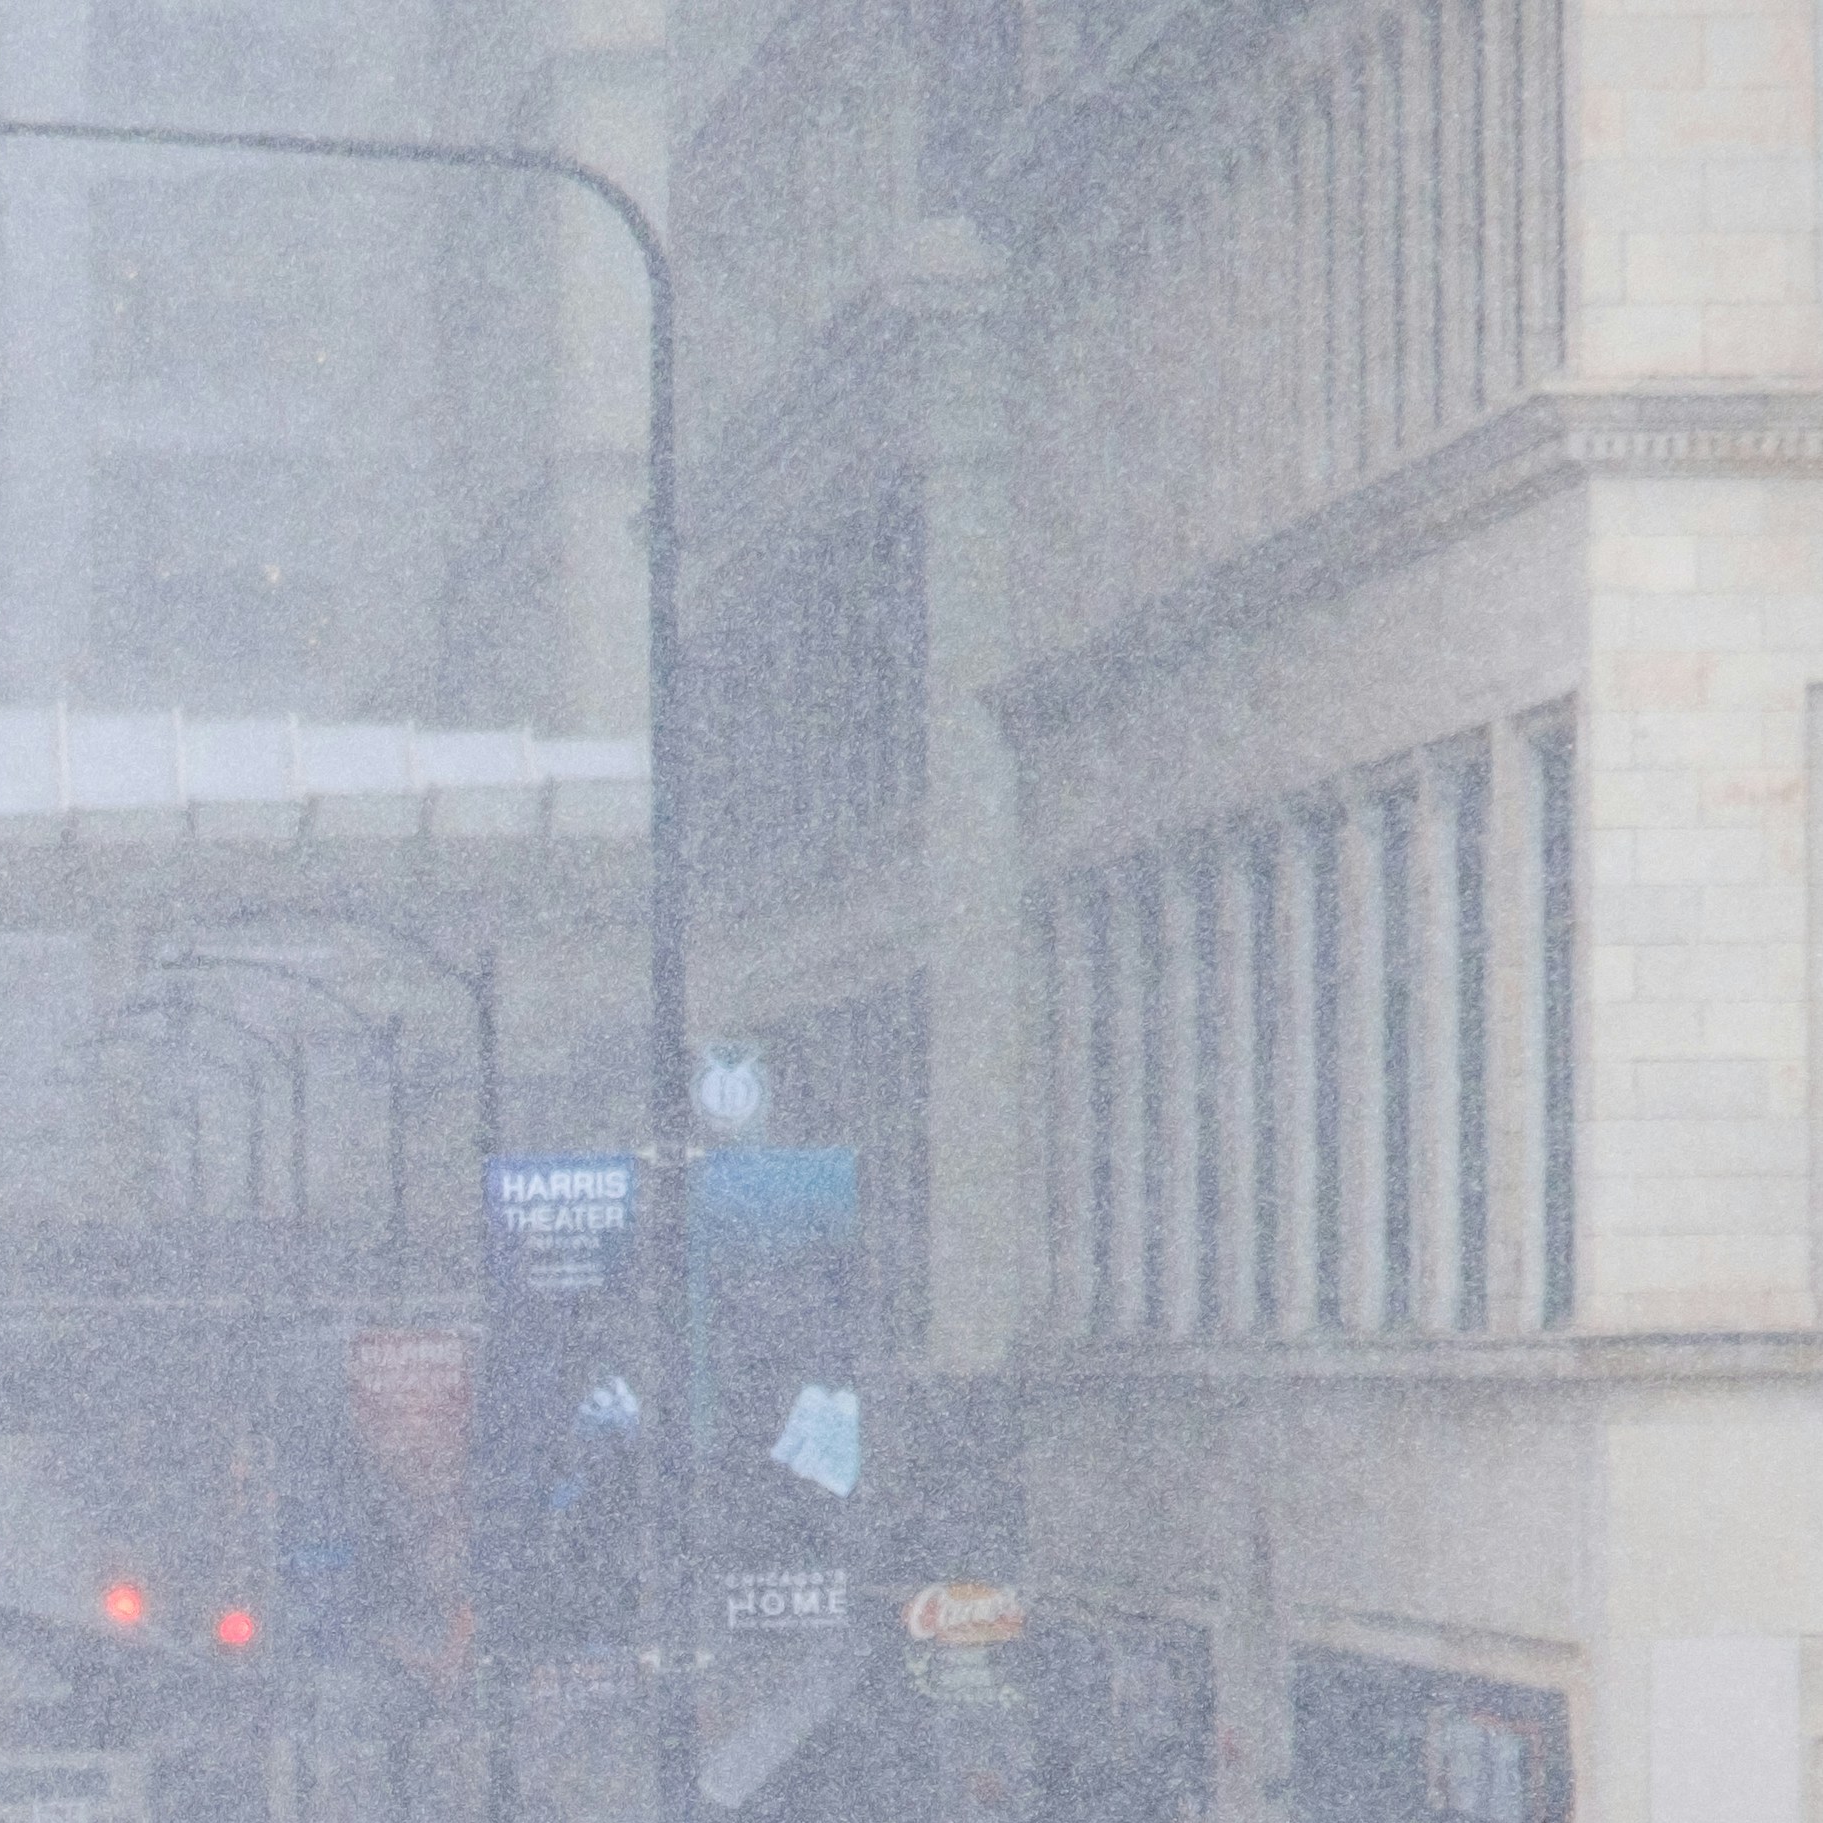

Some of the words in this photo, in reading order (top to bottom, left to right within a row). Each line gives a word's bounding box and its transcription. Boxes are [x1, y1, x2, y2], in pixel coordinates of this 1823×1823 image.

[501, 1171, 627, 1201] HARRIS
[504, 1205, 624, 1231] THEATER
[728, 1589, 846, 1628] HOME
